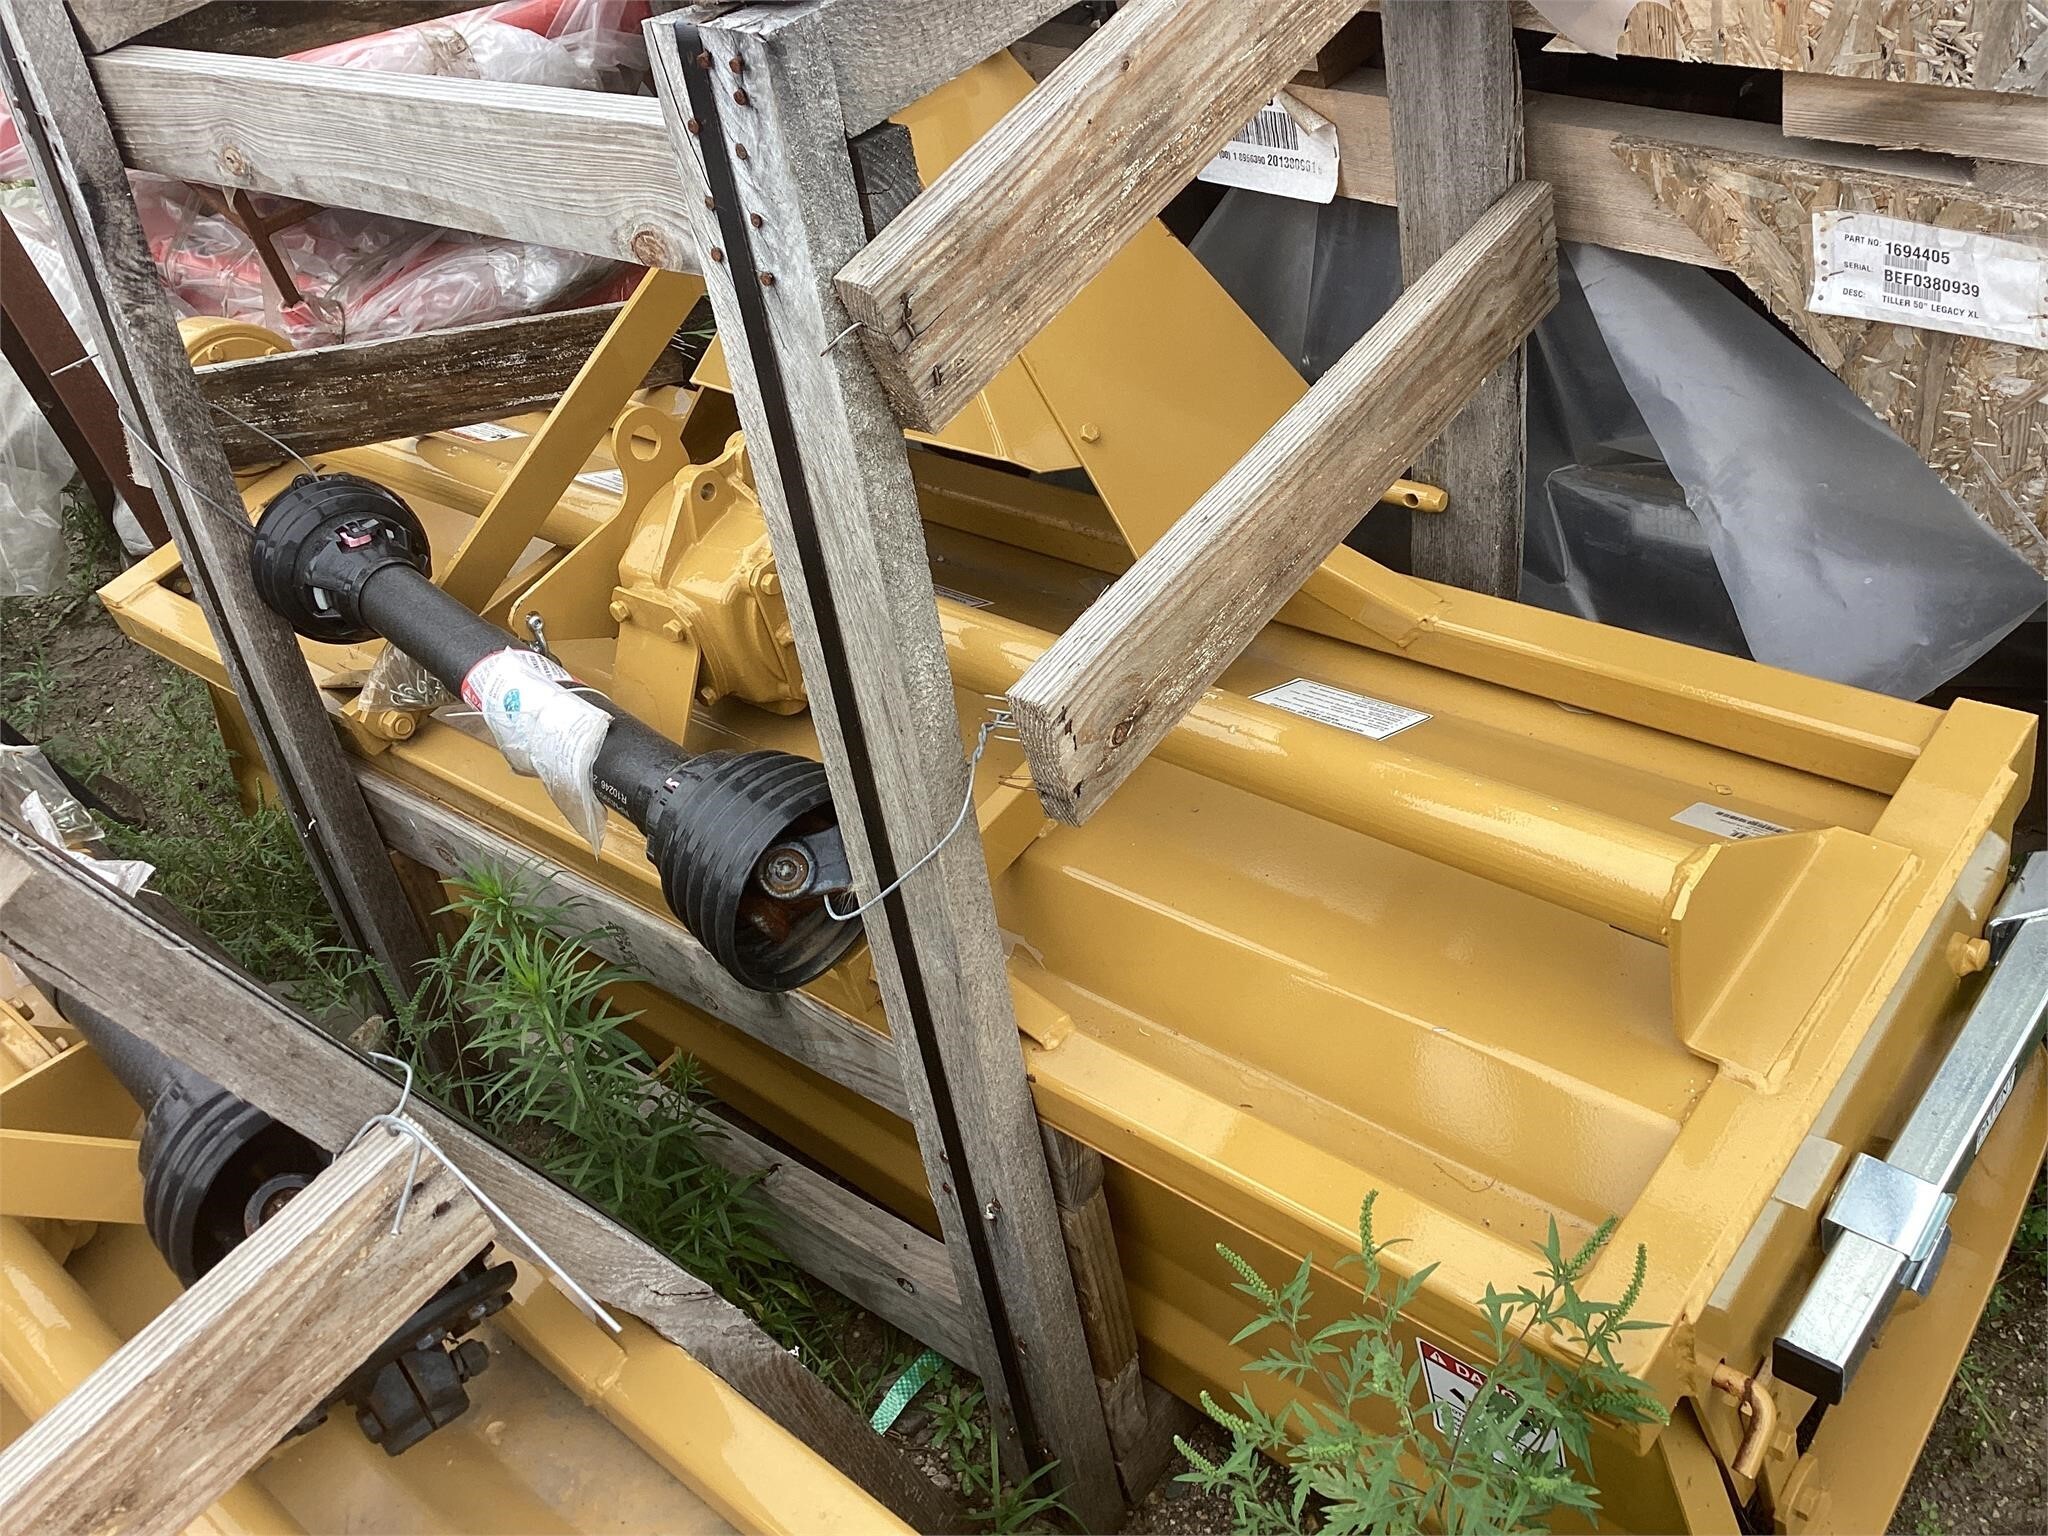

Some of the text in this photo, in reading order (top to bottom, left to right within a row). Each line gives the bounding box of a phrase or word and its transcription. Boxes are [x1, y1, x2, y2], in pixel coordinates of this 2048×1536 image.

[1844, 234, 1882, 248] PART NO:
[1885, 241, 1951, 265] 1694405
[1843, 261, 1873, 273] SERIAL:
[1842, 287, 1866, 299] DESC:
[1884, 269, 1981, 298] BEF0380939
[1882, 295, 1980, 319] TILLER 50" LEGACY XL
